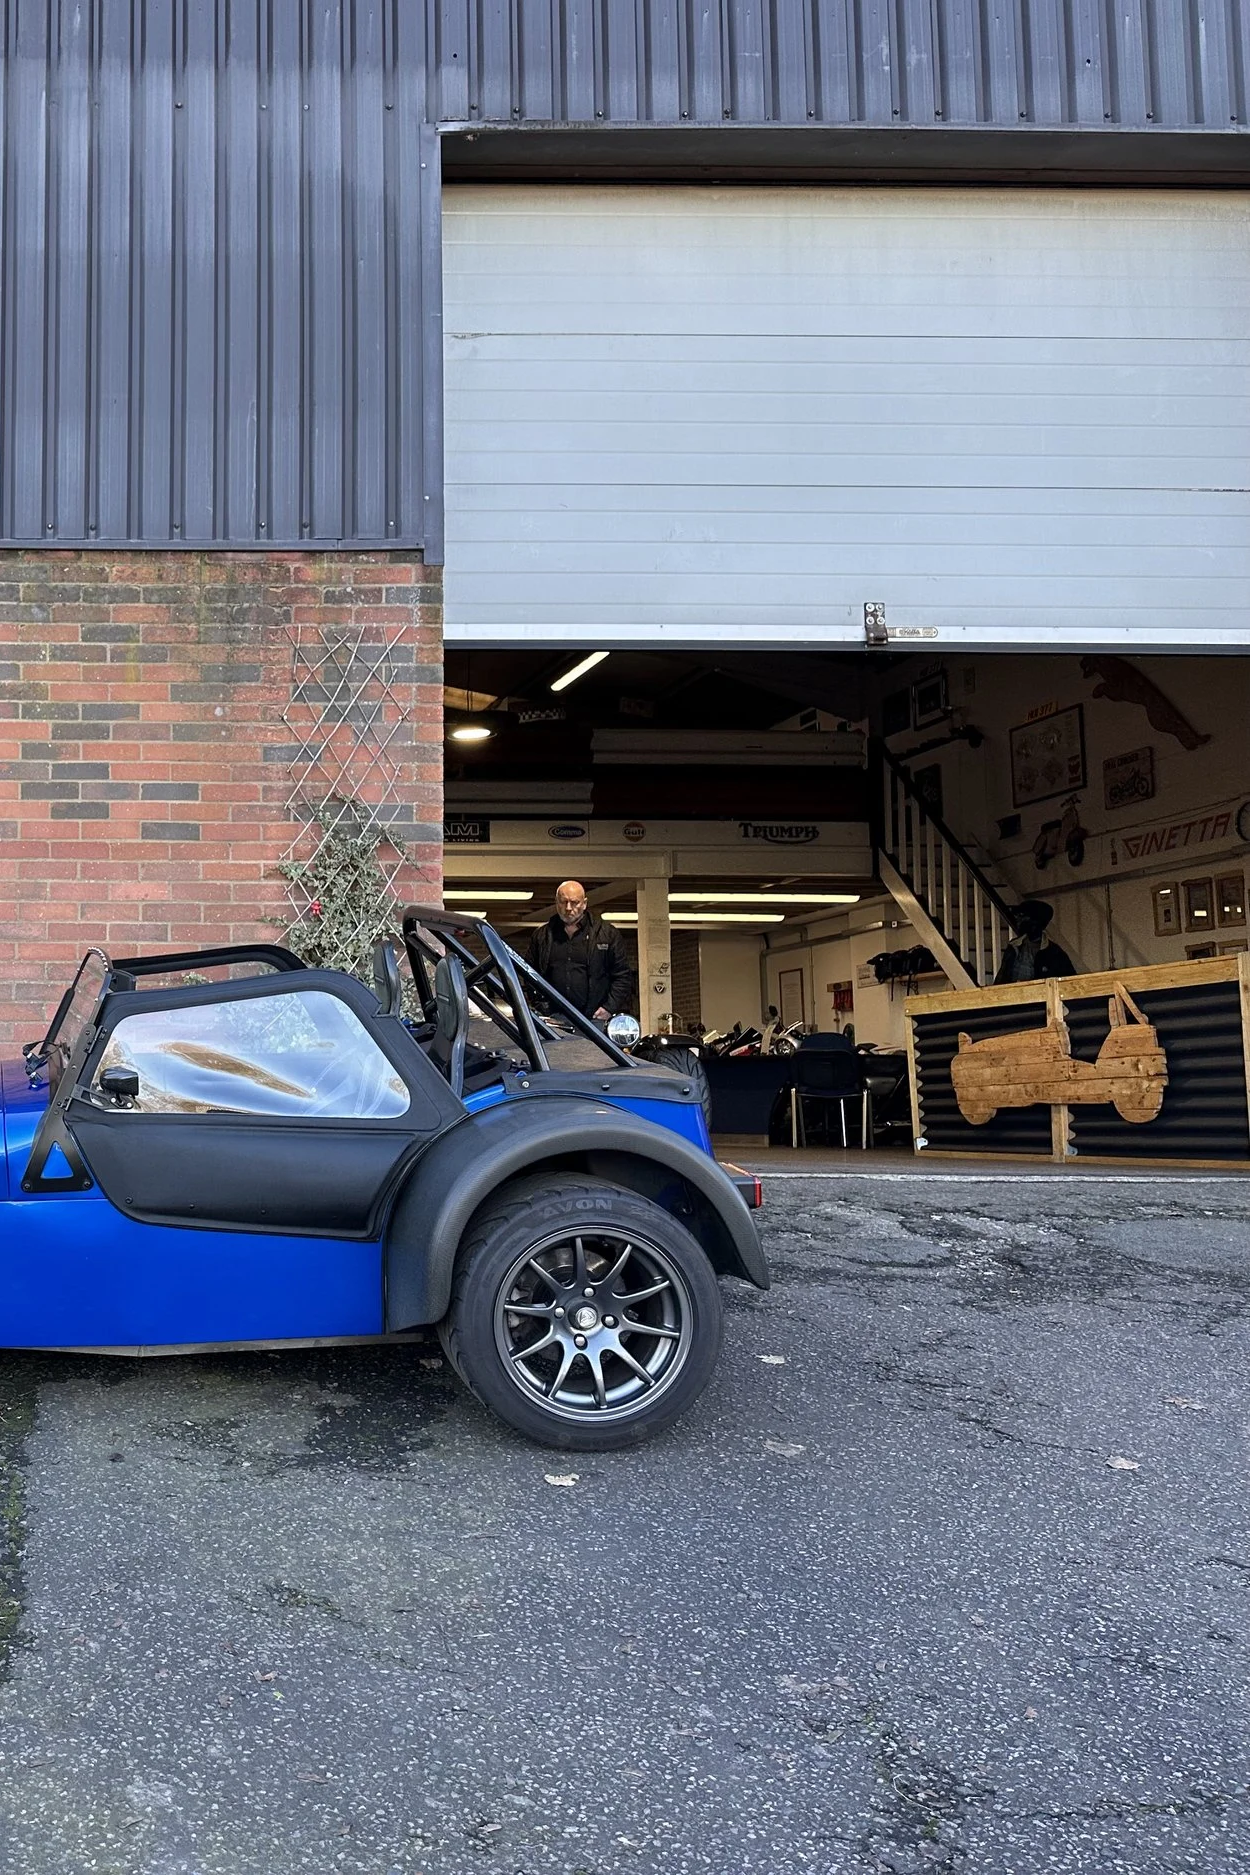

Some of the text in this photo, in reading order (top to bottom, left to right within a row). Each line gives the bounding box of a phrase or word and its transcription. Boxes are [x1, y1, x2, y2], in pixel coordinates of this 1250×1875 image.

[623, 827, 645, 836] Gulf
[738, 822, 820, 844] TRIUMPH
[1121, 810, 1232, 859] GINETTA
[543, 1199, 613, 1220] AVON
